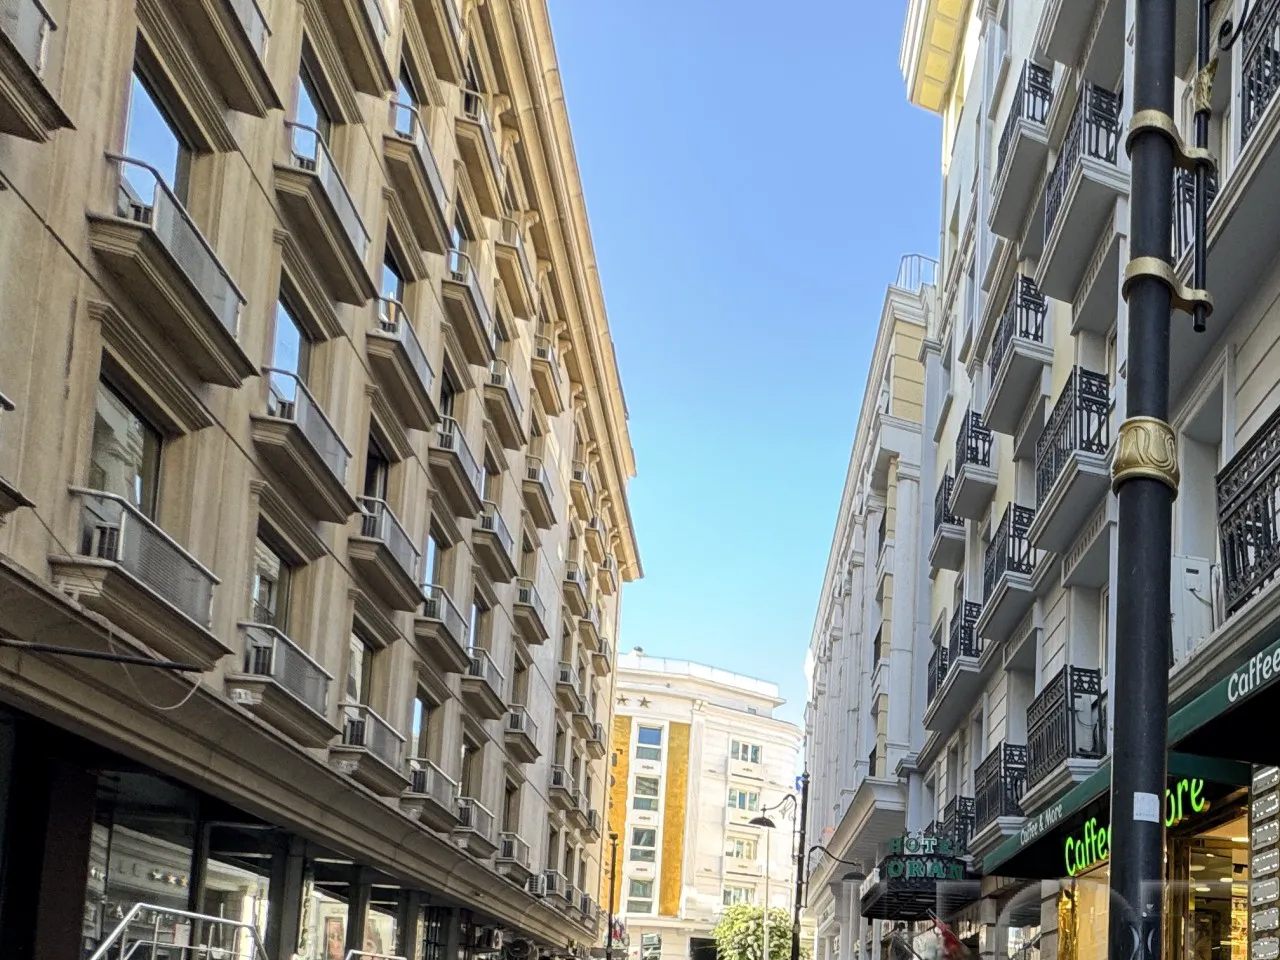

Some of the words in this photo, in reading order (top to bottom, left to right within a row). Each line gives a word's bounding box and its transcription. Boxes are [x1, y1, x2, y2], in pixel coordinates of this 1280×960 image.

[1165, 777, 1206, 828] ore
[888, 836, 968, 857] HOTEL
[887, 860, 964, 880] ORAN
